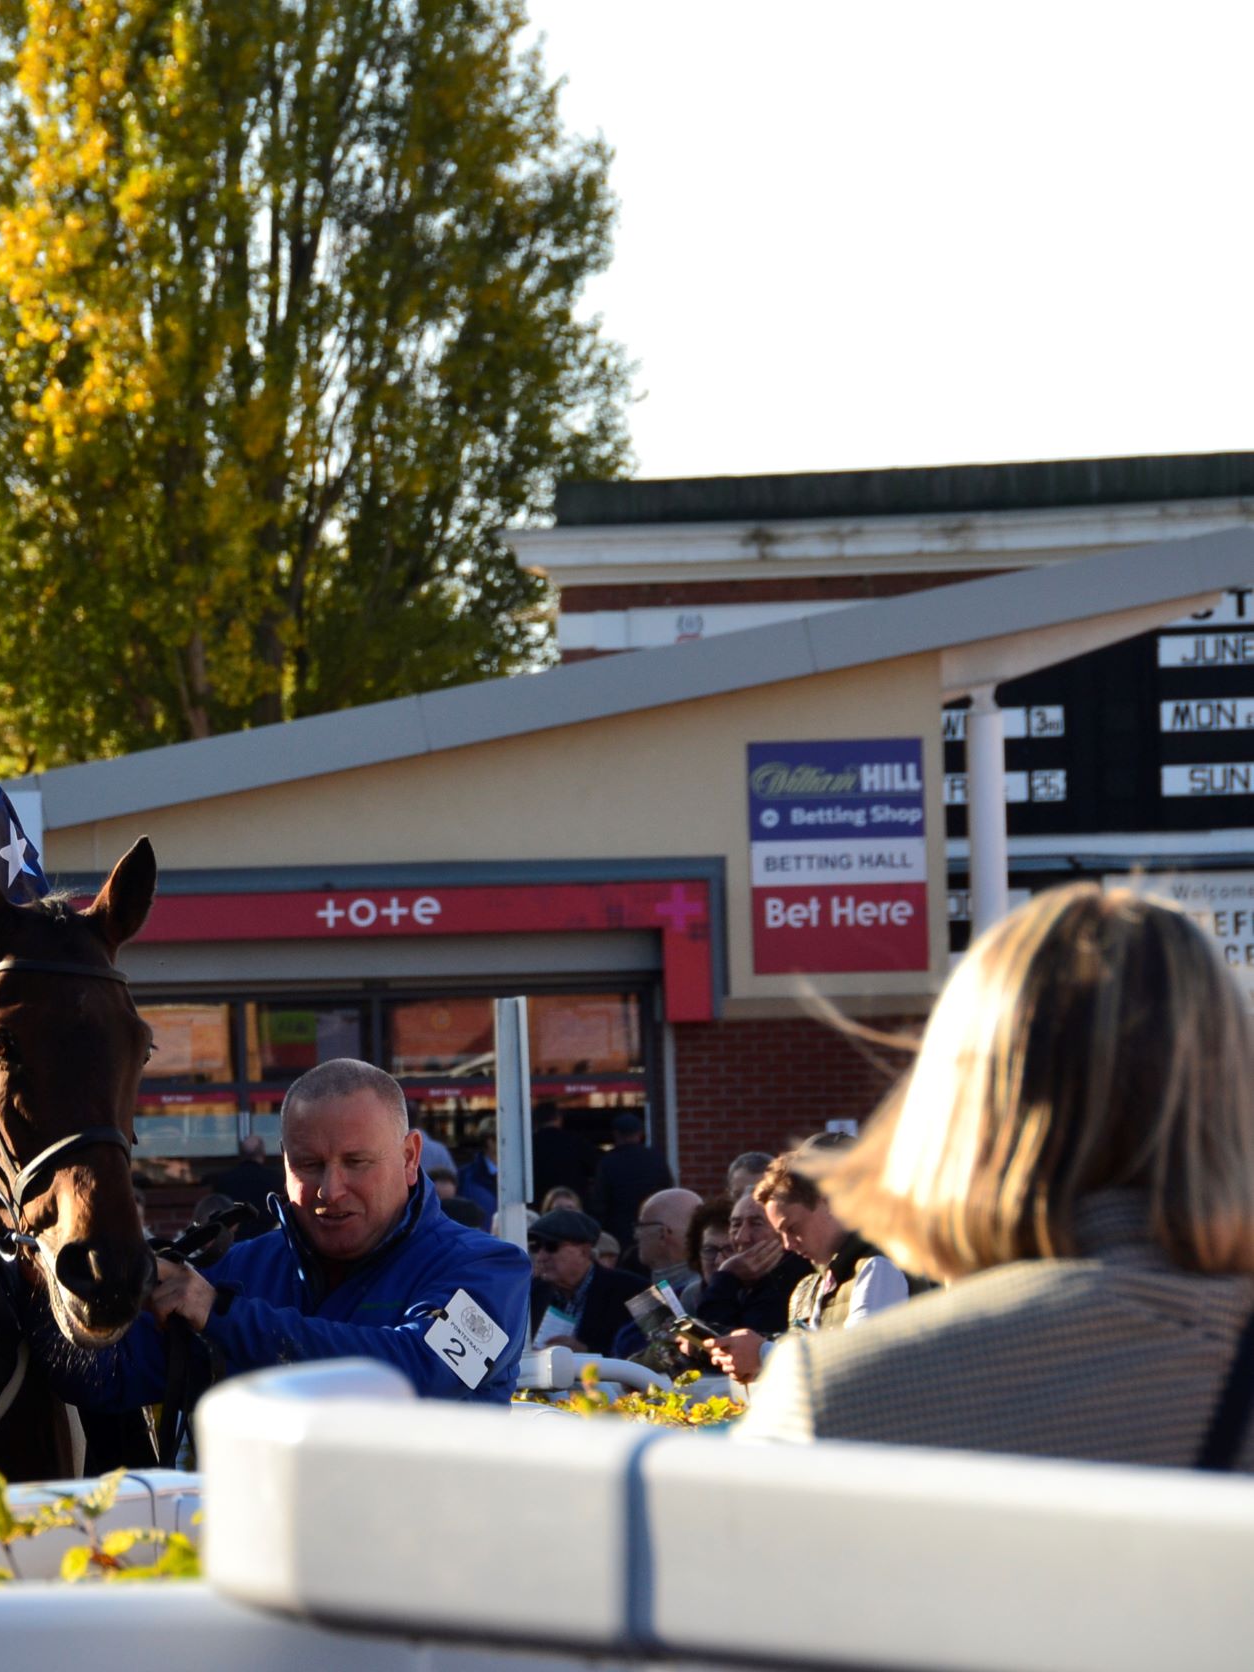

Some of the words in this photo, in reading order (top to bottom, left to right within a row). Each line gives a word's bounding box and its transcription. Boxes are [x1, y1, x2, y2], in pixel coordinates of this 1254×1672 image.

[1171, 702, 1237, 730] MON
[860, 763, 923, 793] HILL
[1189, 766, 1251, 795] SUN
[790, 806, 867, 827] Betting
[869, 803, 923, 825] Shop
[763, 854, 854, 873] BETTING
[858, 852, 913, 870] HALL
[764, 896, 821, 929] Bet
[830, 896, 914, 927] Here
[442, 1337, 467, 1367] 2
[450, 1321, 484, 1356] PONTEFRACT
